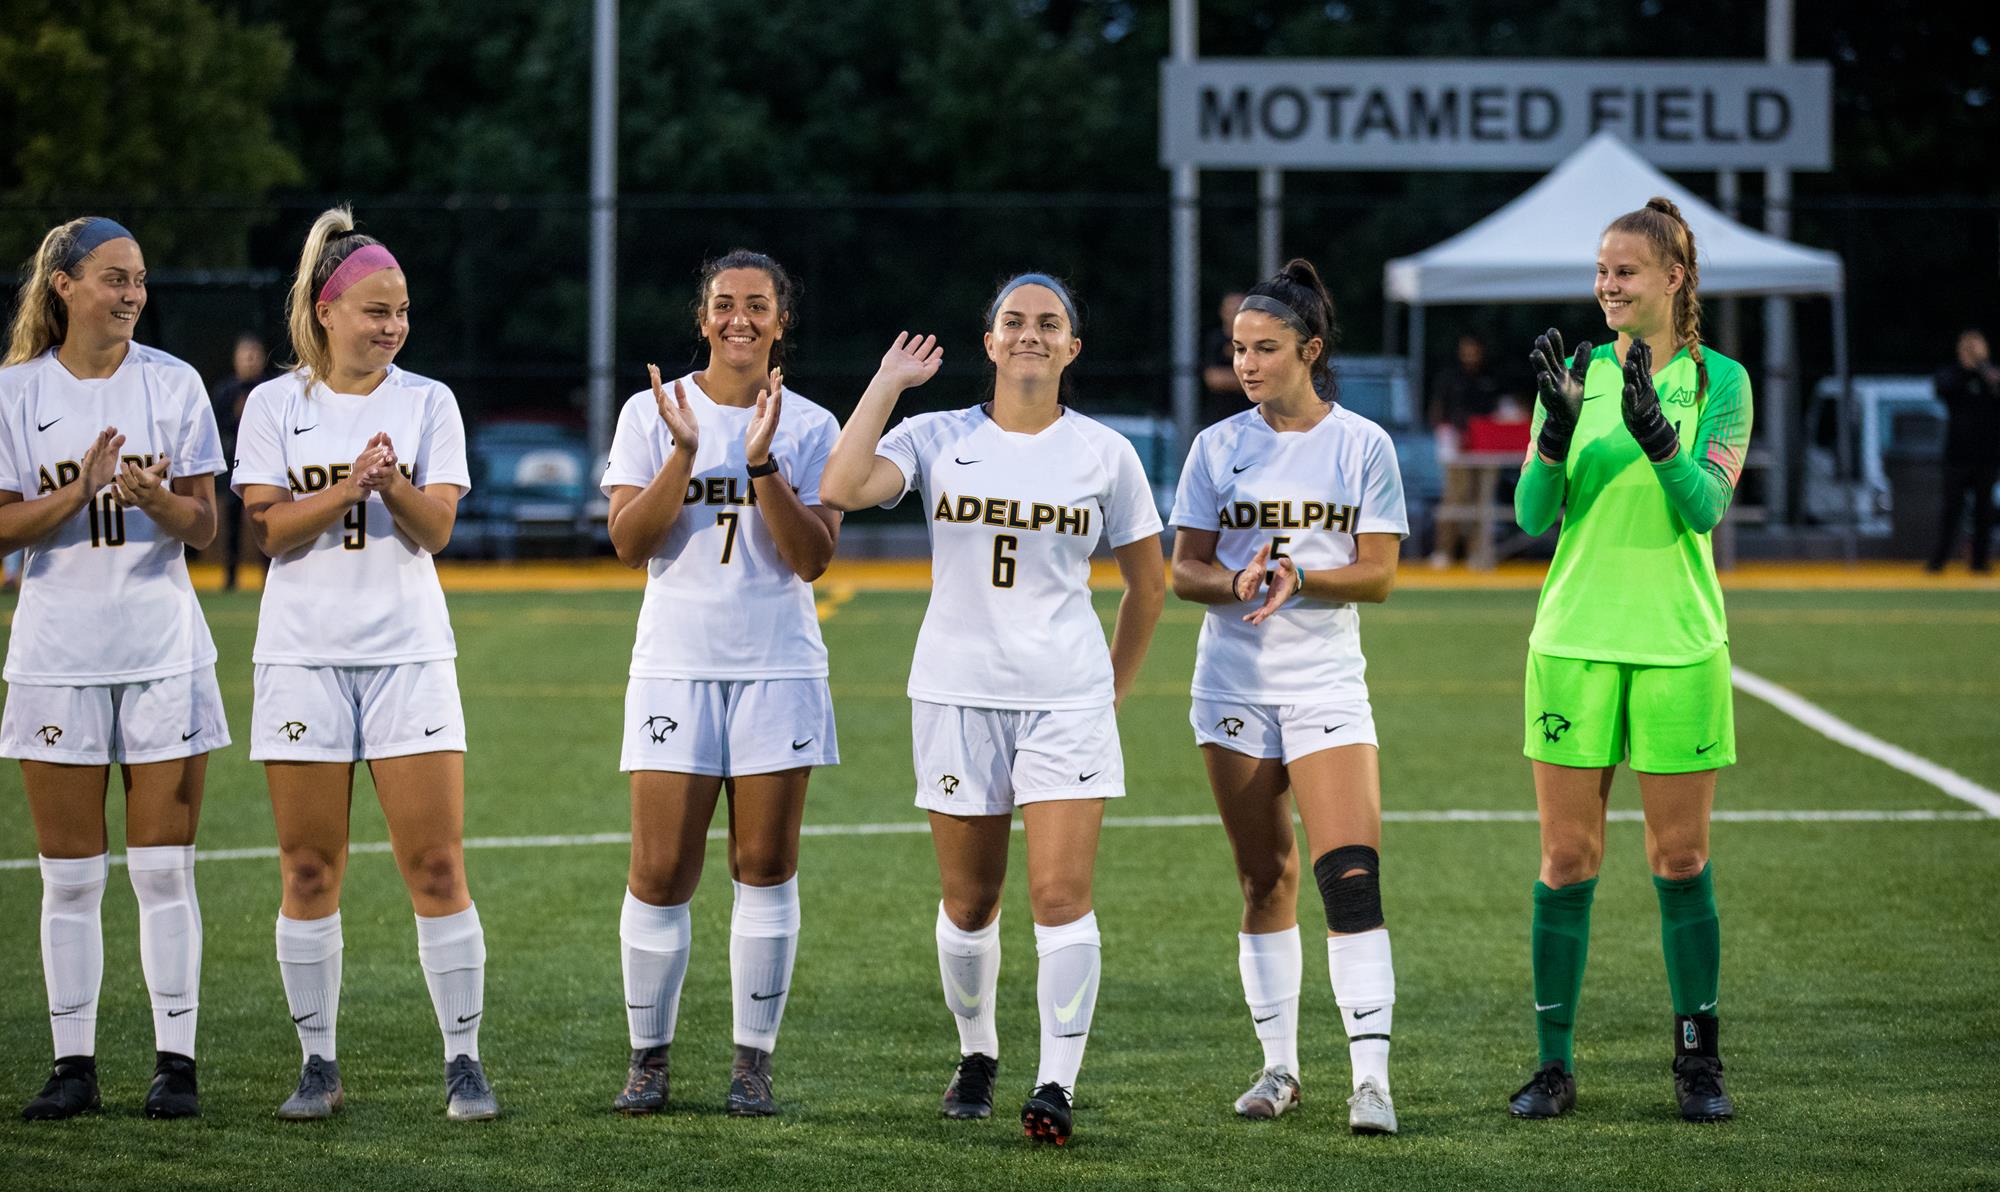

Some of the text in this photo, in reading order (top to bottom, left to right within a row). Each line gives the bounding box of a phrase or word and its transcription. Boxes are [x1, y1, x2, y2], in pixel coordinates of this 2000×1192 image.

[1198, 85, 1793, 143] MOTAMED FIELD
[89, 492, 126, 548] 10
[343, 500, 366, 550] 9
[716, 511, 739, 565] 7
[934, 491, 1090, 536] ADELPHI
[1219, 500, 1361, 534] ADELPHI
[992, 534, 1018, 589] 6
